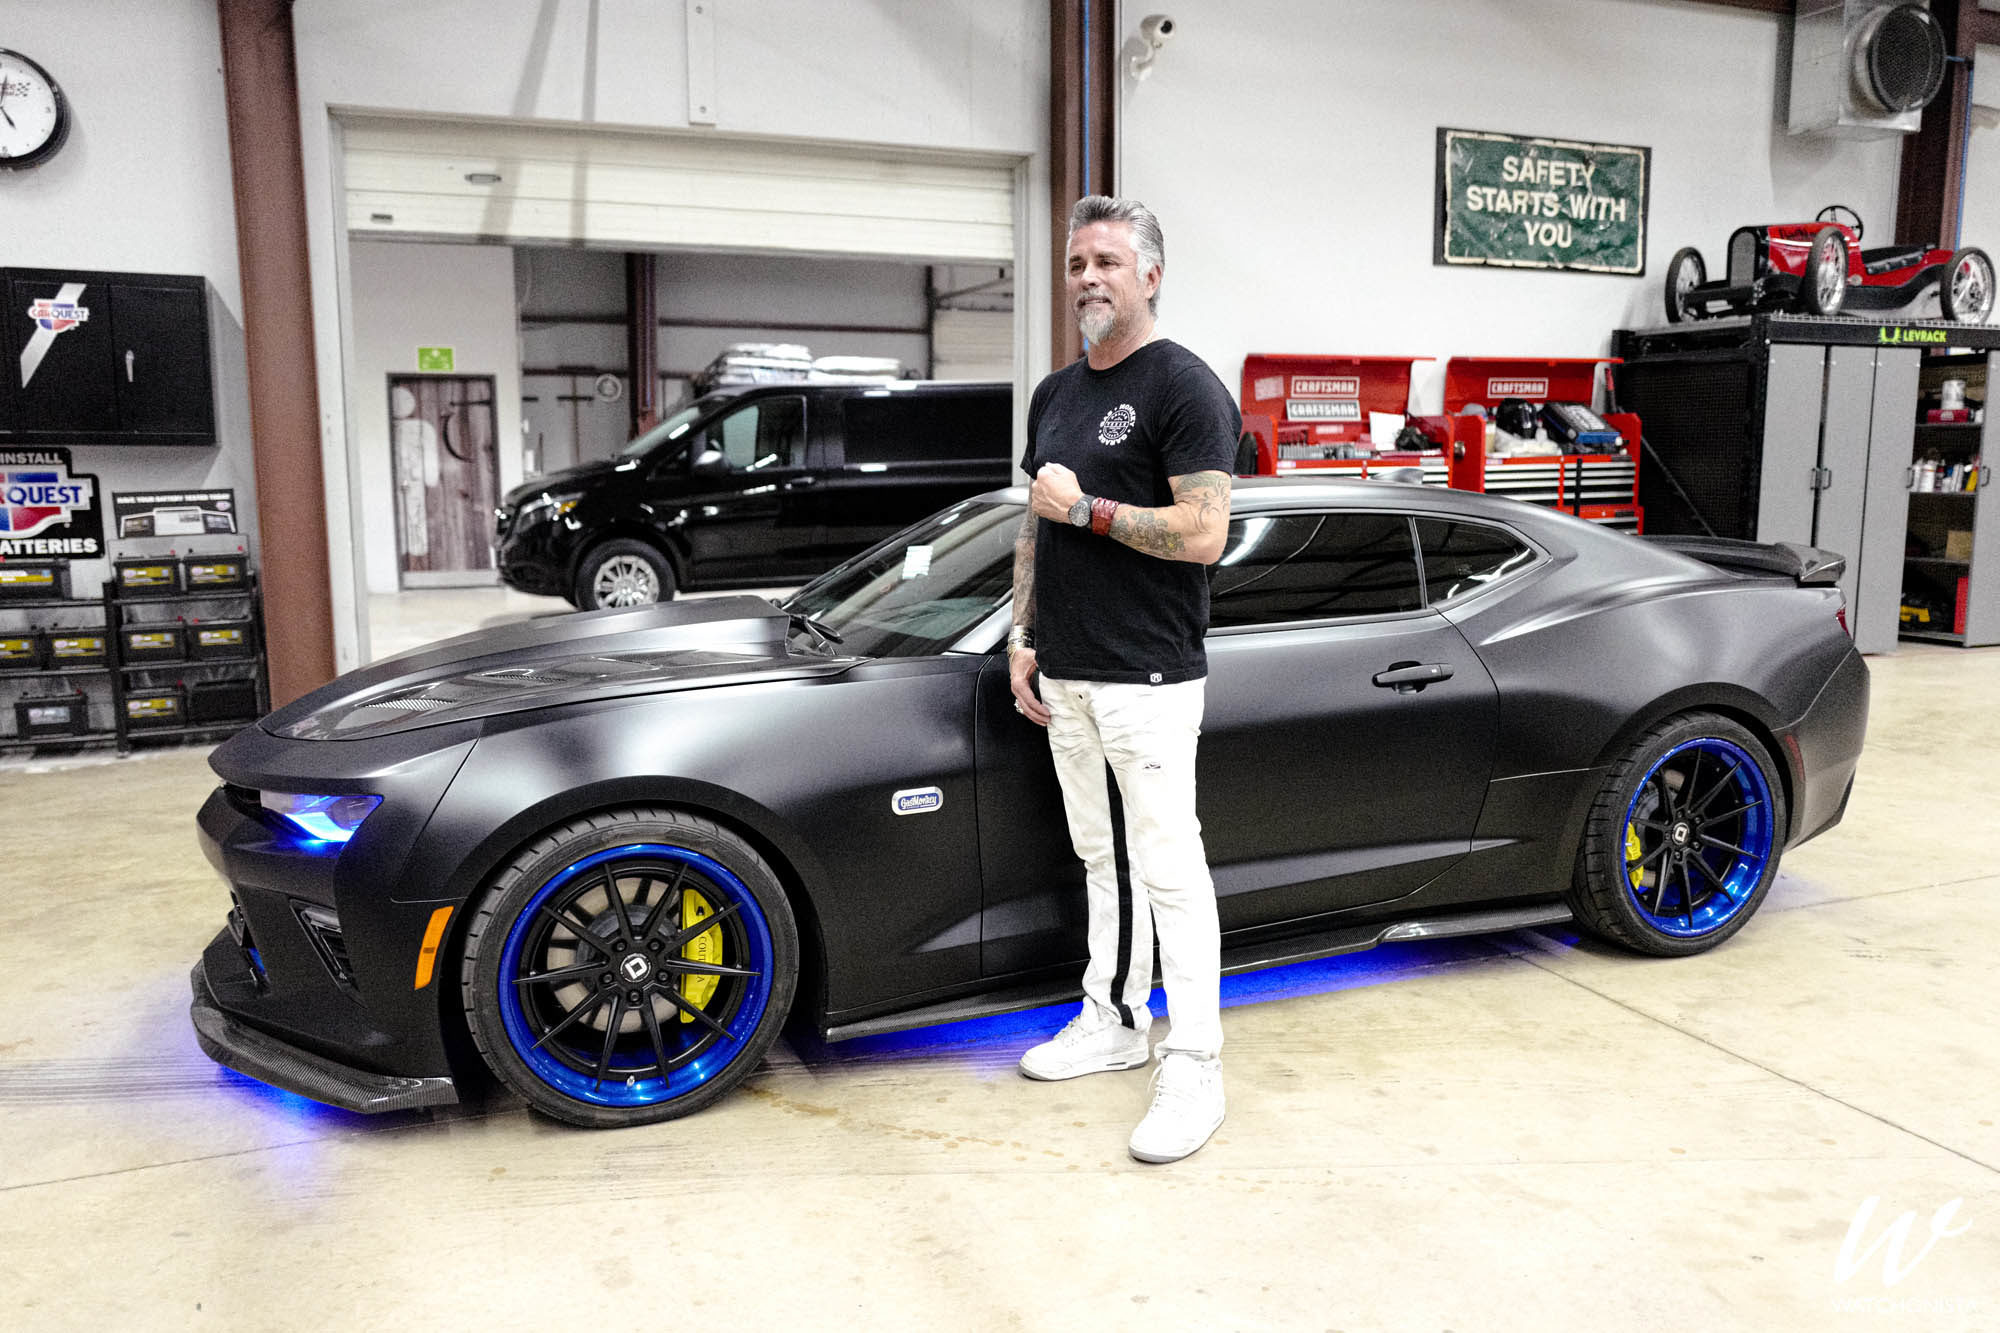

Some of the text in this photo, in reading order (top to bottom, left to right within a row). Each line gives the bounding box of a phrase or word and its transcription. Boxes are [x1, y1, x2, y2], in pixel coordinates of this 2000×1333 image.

[1502, 156, 1595, 187] SAFETY
[1466, 185, 1626, 222] STARTS WITH
[1523, 220, 1572, 248] YOU
[1903, 328, 1947, 343] LEVRACK
[1296, 381, 1355, 393] CRAFTSMAN
[1491, 382, 1545, 394] CRAFTSMAN
[1291, 403, 1356, 416] CRAFTSMAN
[0, 452, 64, 464] INSTALL
[0, 537, 98, 555] ATTERIES
